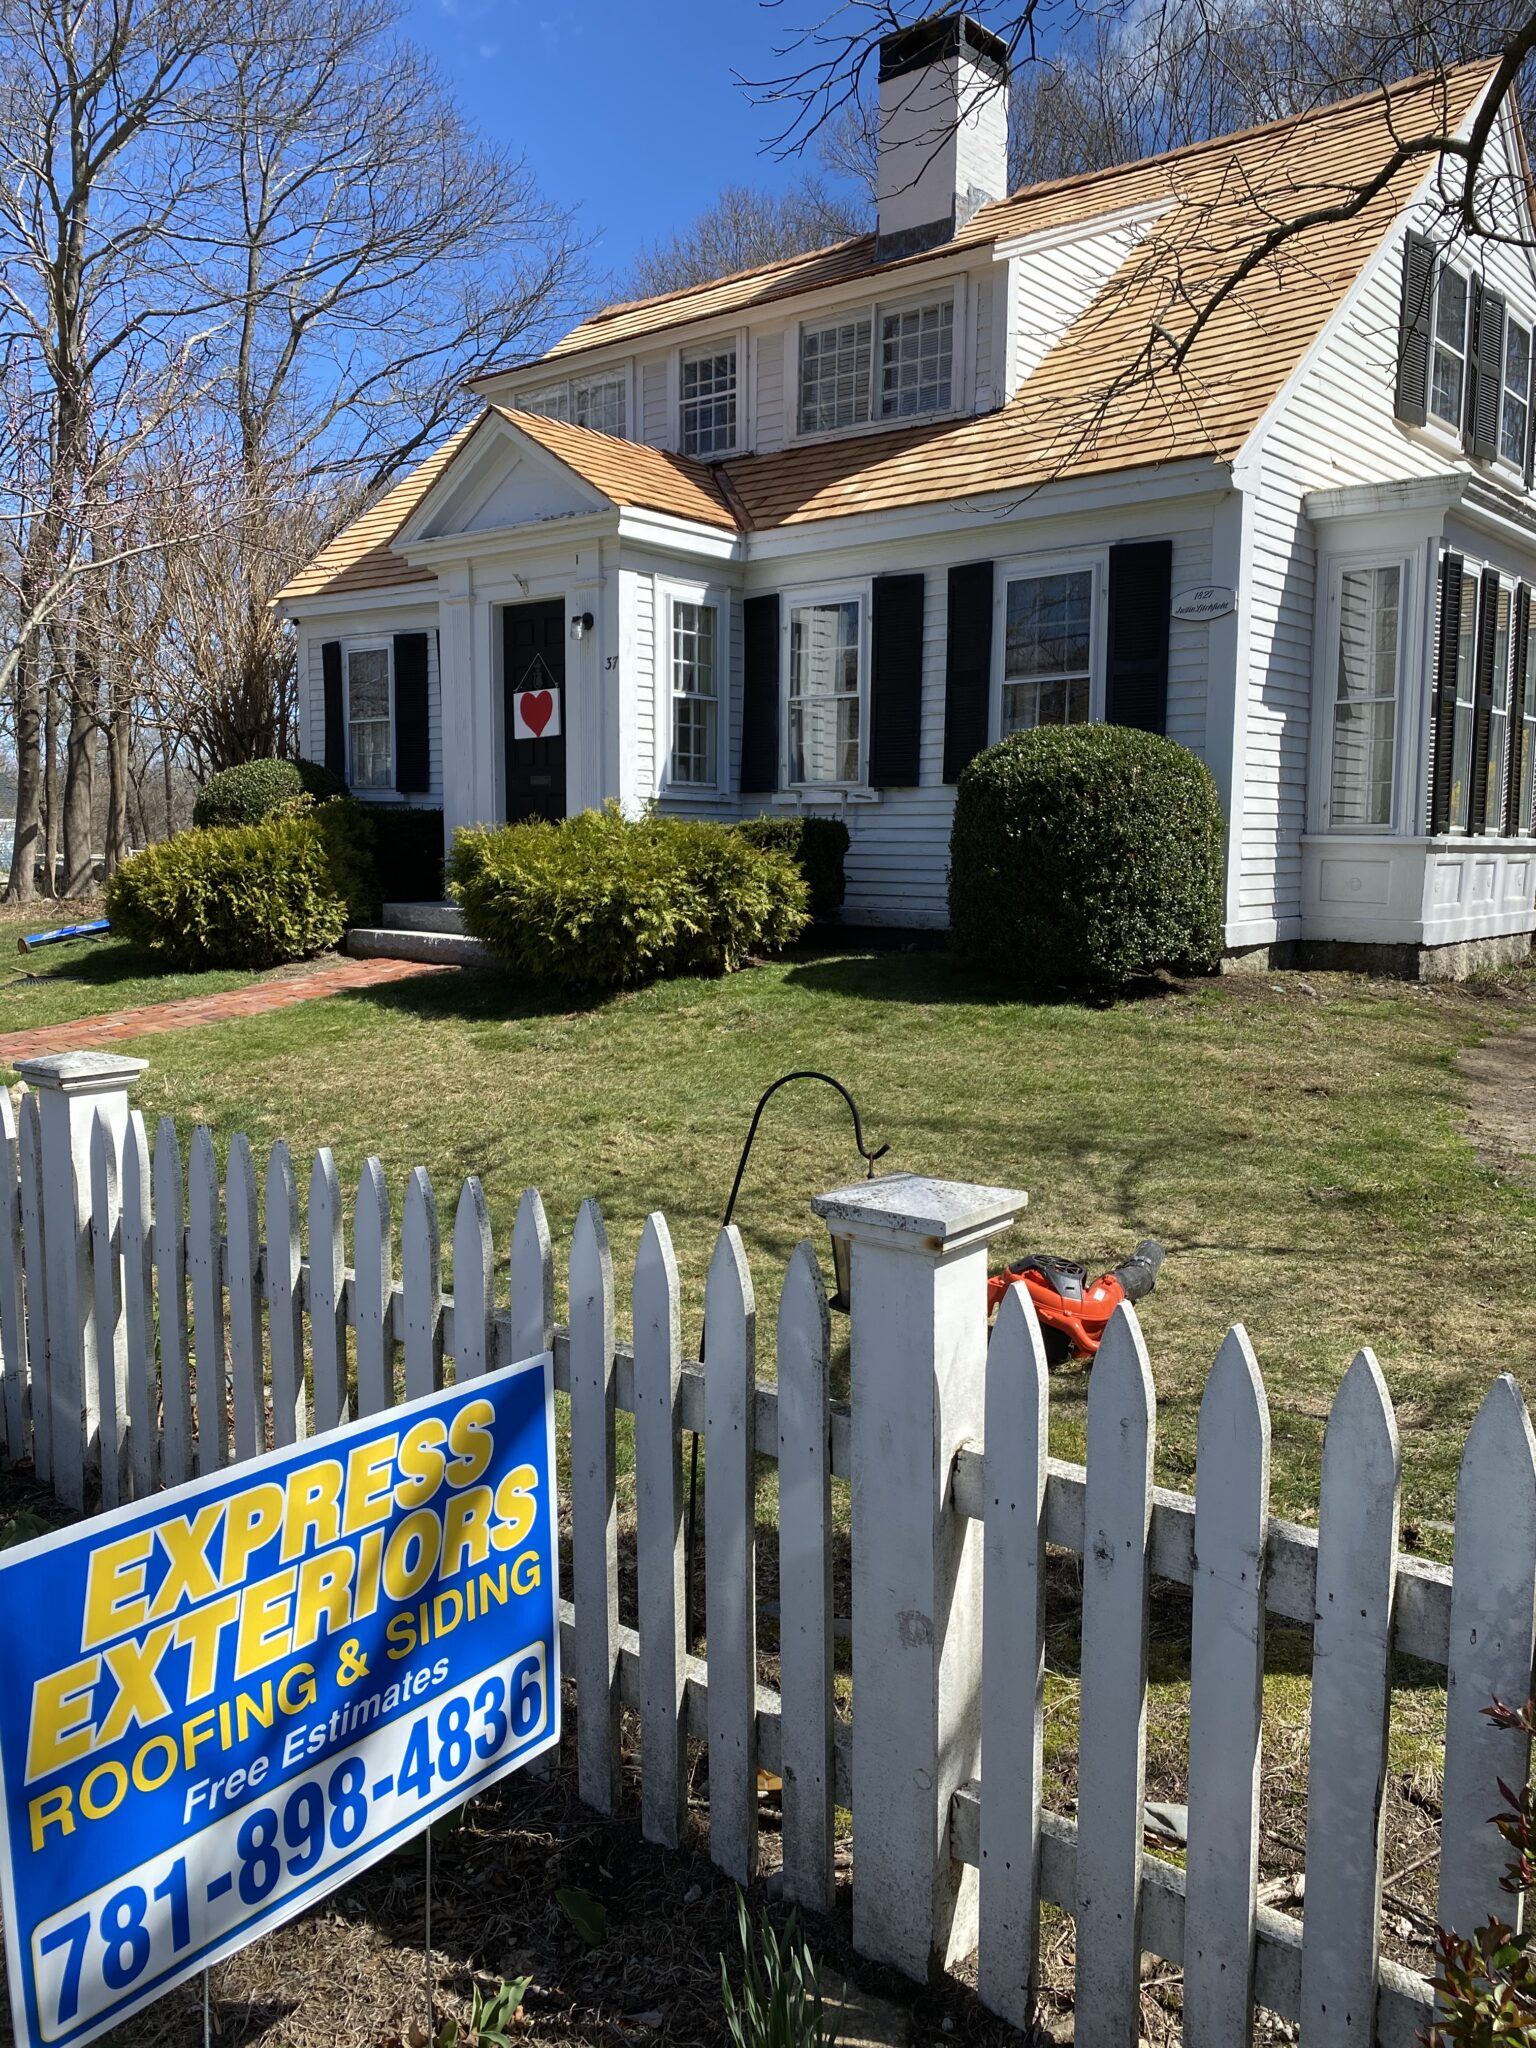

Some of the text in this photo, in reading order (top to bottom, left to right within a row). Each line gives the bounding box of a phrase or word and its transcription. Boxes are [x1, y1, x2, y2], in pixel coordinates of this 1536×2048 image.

[605, 655, 619, 670] 37
[24, 1463, 539, 1786] EXTERIORS
[81, 1399, 496, 1653] EXPRESS
[28, 1550, 541, 1853] ROOFING & SIDING
[182, 1656, 450, 1826] Free Estimates
[40, 1655, 543, 2027] 781-898-4836
